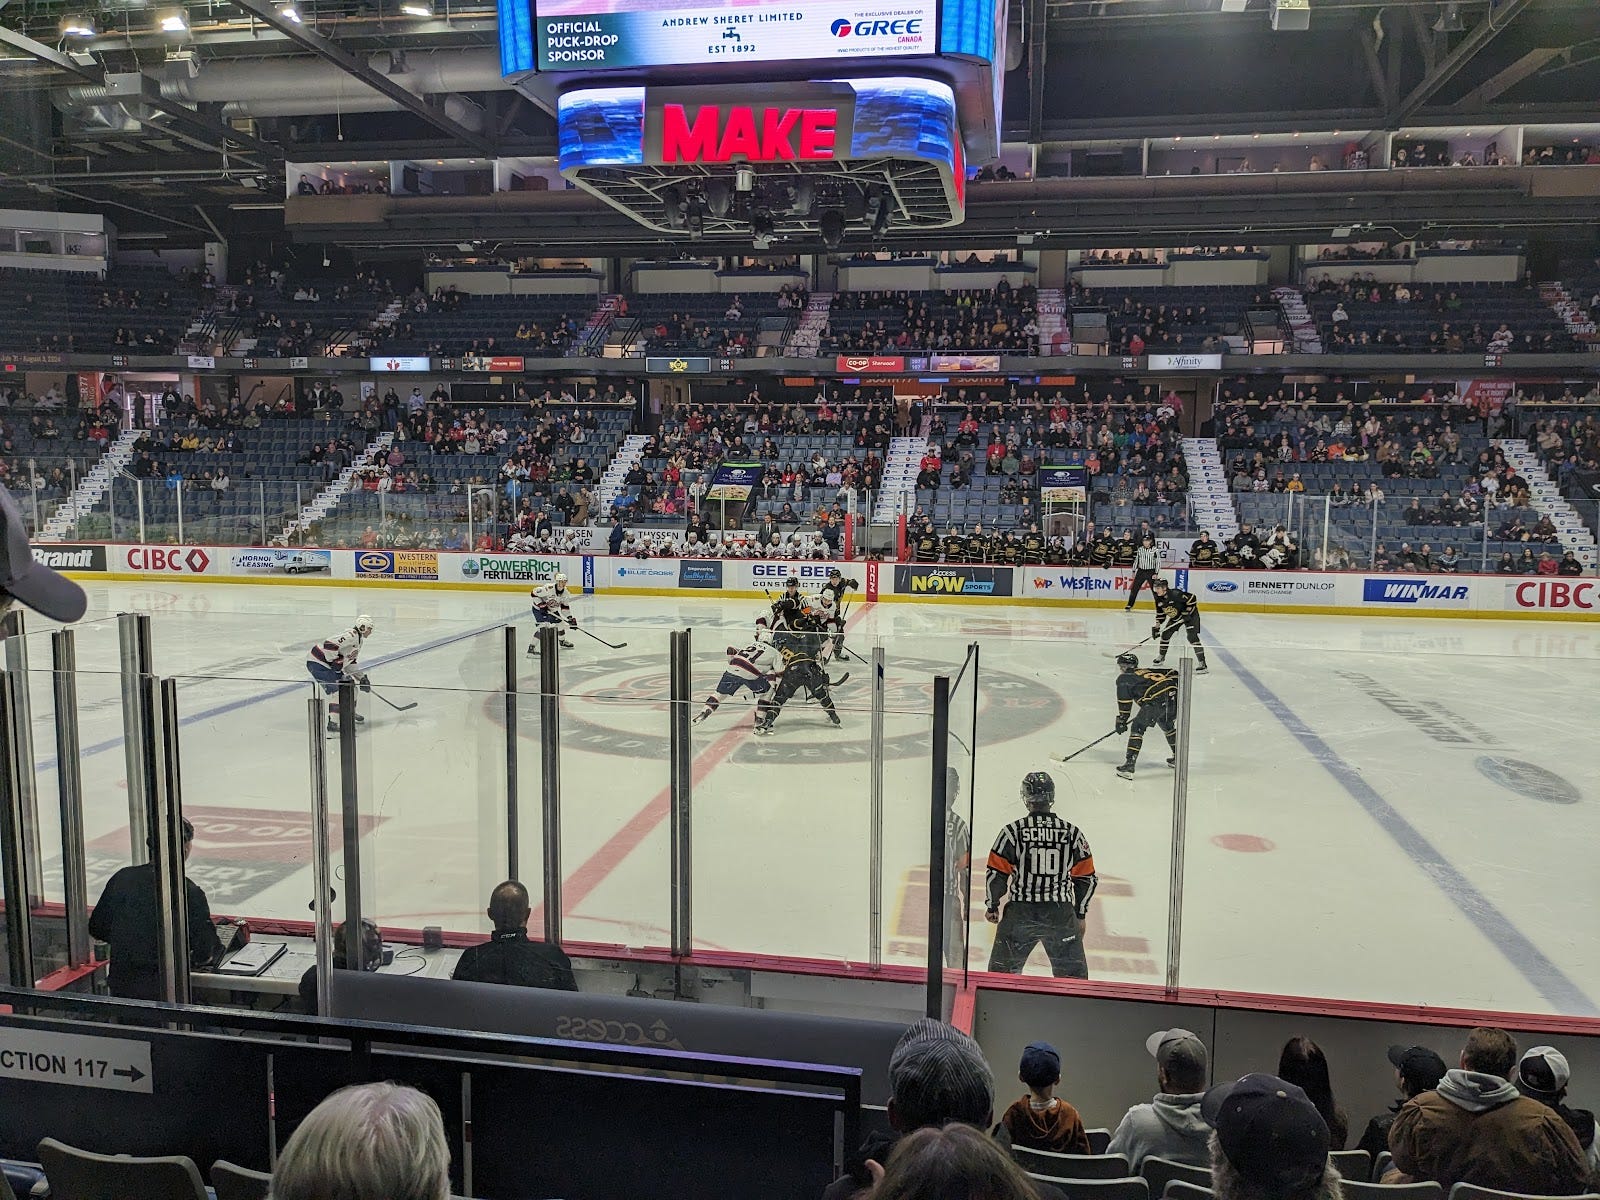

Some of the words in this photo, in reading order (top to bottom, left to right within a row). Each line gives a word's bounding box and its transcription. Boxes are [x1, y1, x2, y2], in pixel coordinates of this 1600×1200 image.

[662, 17, 709, 27] ANDREW
[713, 14, 753, 25] SHERET
[759, 12, 803, 23] LIMITED
[547, 21, 602, 34] OFFICIAL
[854, 19, 923, 36] GREE
[548, 35, 619, 48] PUCK-DROP
[548, 49, 605, 62] SPONSOR
[708, 46, 726, 54] EST
[731, 45, 756, 53] 1892
[662, 104, 837, 162] MAKE
[1172, 355, 1203, 367] Affinity
[32, 549, 93, 567] Brandt
[127, 548, 183, 570] CIBC
[398, 553, 437, 561] WESTERN
[398, 566, 437, 574] PRINTERS
[484, 571, 533, 580] FERTILIZER
[535, 571, 551, 581] Inc.
[752, 564, 788, 576] GEE
[911, 575, 966, 592] NOW
[1060, 575, 1112, 590] WESTERN
[1211, 582, 1233, 591] Ford
[1248, 581, 1295, 589] BENNETT
[1296, 582, 1335, 590] DUNLOP
[1383, 583, 1468, 600] WINMAR
[1515, 581, 1594, 608] CIBC
[1022, 828, 1068, 843] SCHUTZ
[1029, 847, 1061, 875] 110
[0, 1050, 67, 1075] CTION
[74, 1057, 108, 1079] 117
